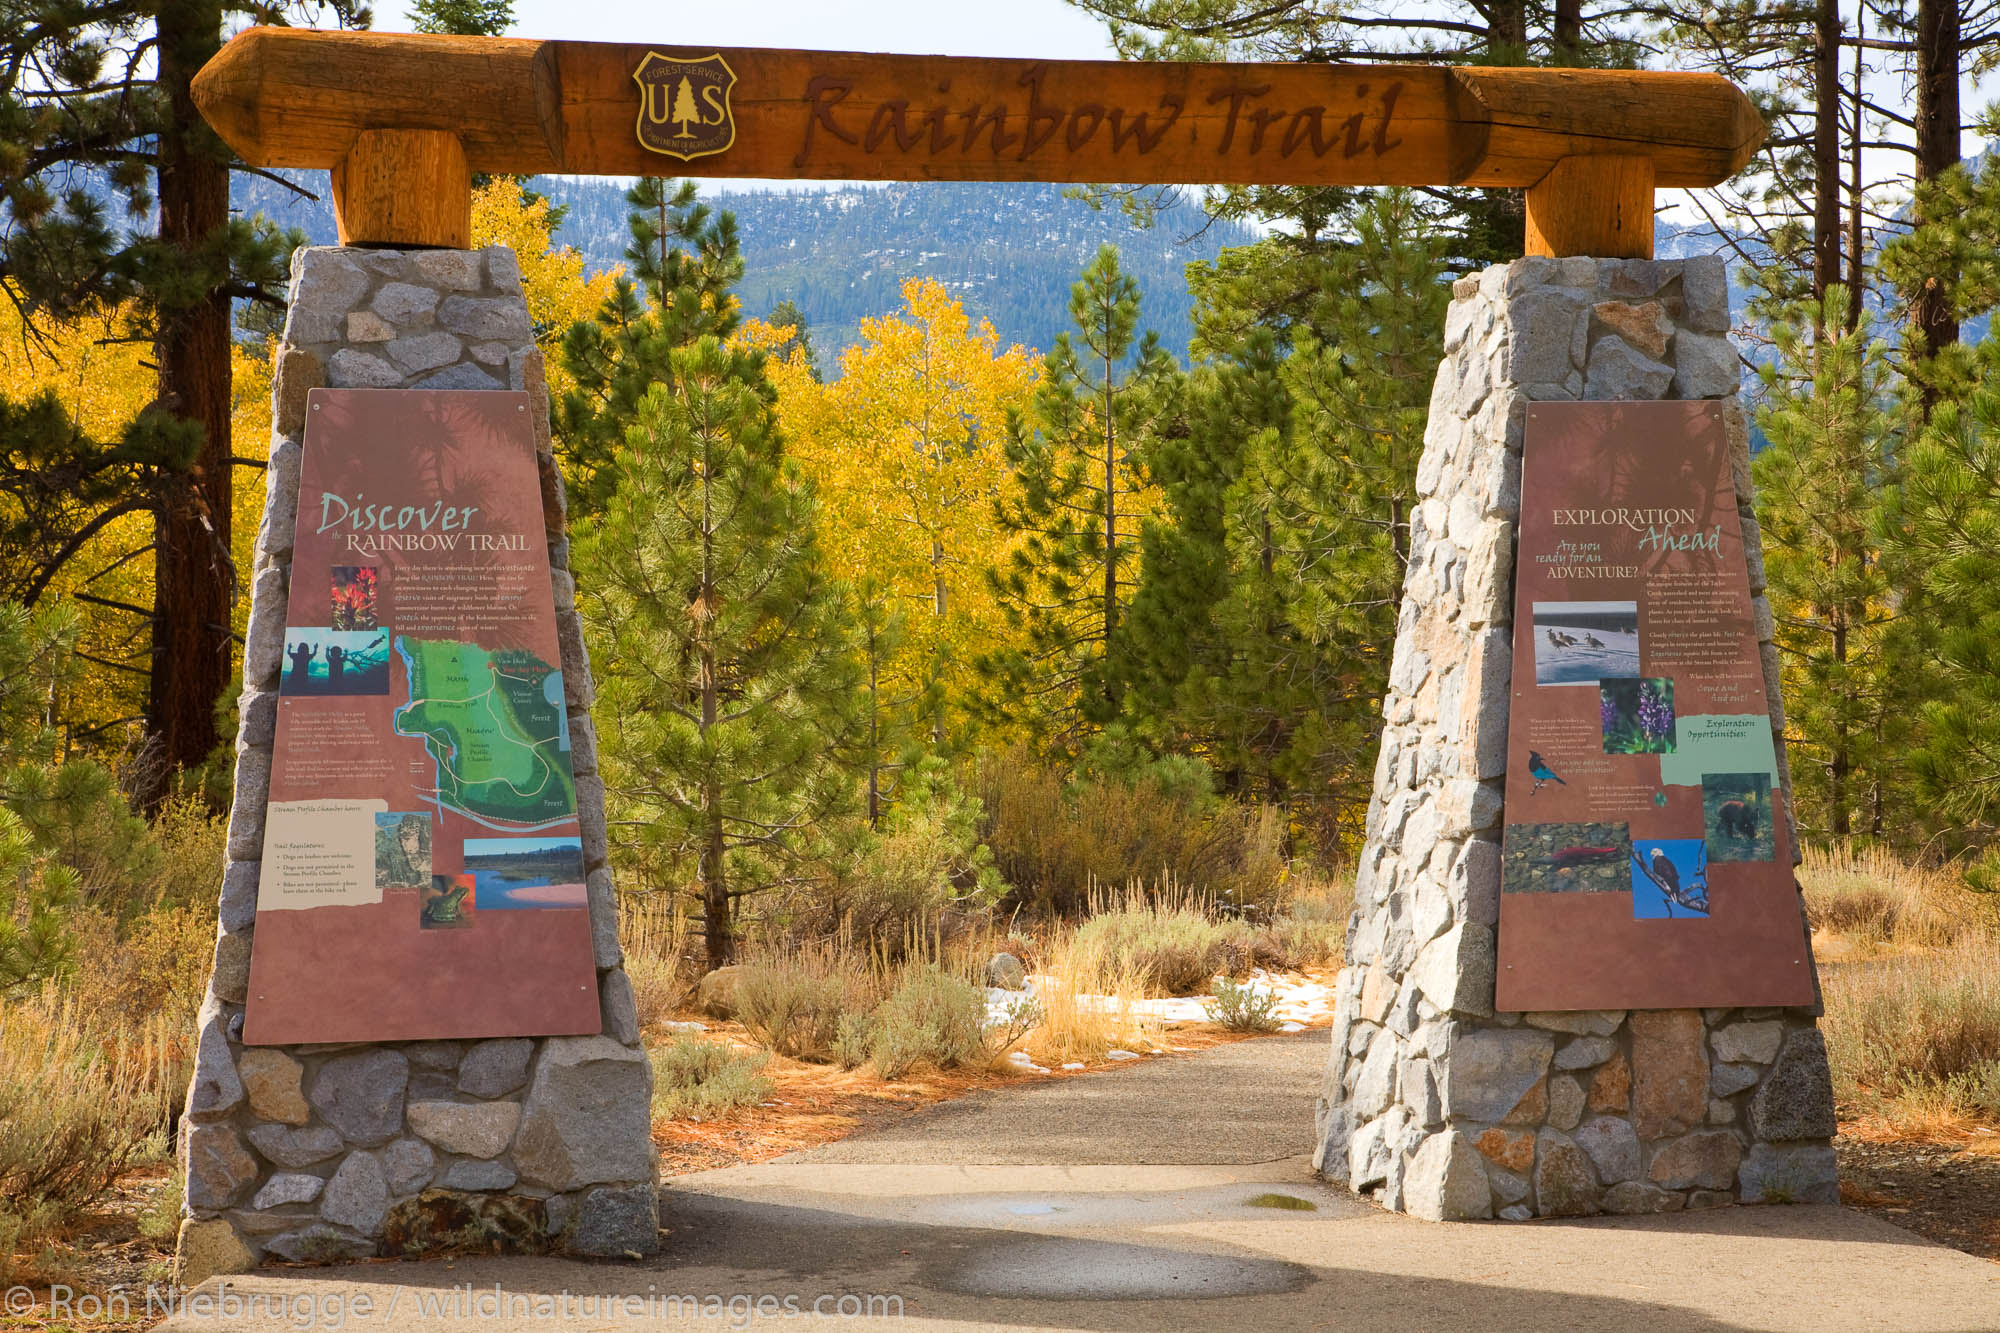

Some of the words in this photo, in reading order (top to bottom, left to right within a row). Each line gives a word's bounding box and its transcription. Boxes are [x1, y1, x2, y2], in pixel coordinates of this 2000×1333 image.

[646, 64, 681, 81] FOREST
[685, 64, 725, 82] SERVICE
[795, 63, 1185, 168] Rainbow
[1207, 82, 1404, 159] Trail
[316, 492, 479, 534] Discover
[1552, 508, 1696, 532] EXPLORATION
[331, 530, 342, 540] the
[346, 532, 463, 557] RAINBOW
[465, 533, 531, 551] TRAIL
[1556, 539, 1579, 551] Are
[1580, 542, 1601, 556] you
[1639, 523, 1724, 559] Ahead
[1535, 551, 1566, 566] ready
[1567, 551, 1585, 567] for
[1586, 553, 1602, 563] an
[1547, 566, 1639, 579] ADVENTURE?
[1706, 719, 1756, 730] Exploration
[1688, 729, 1747, 743] Opportunities:
